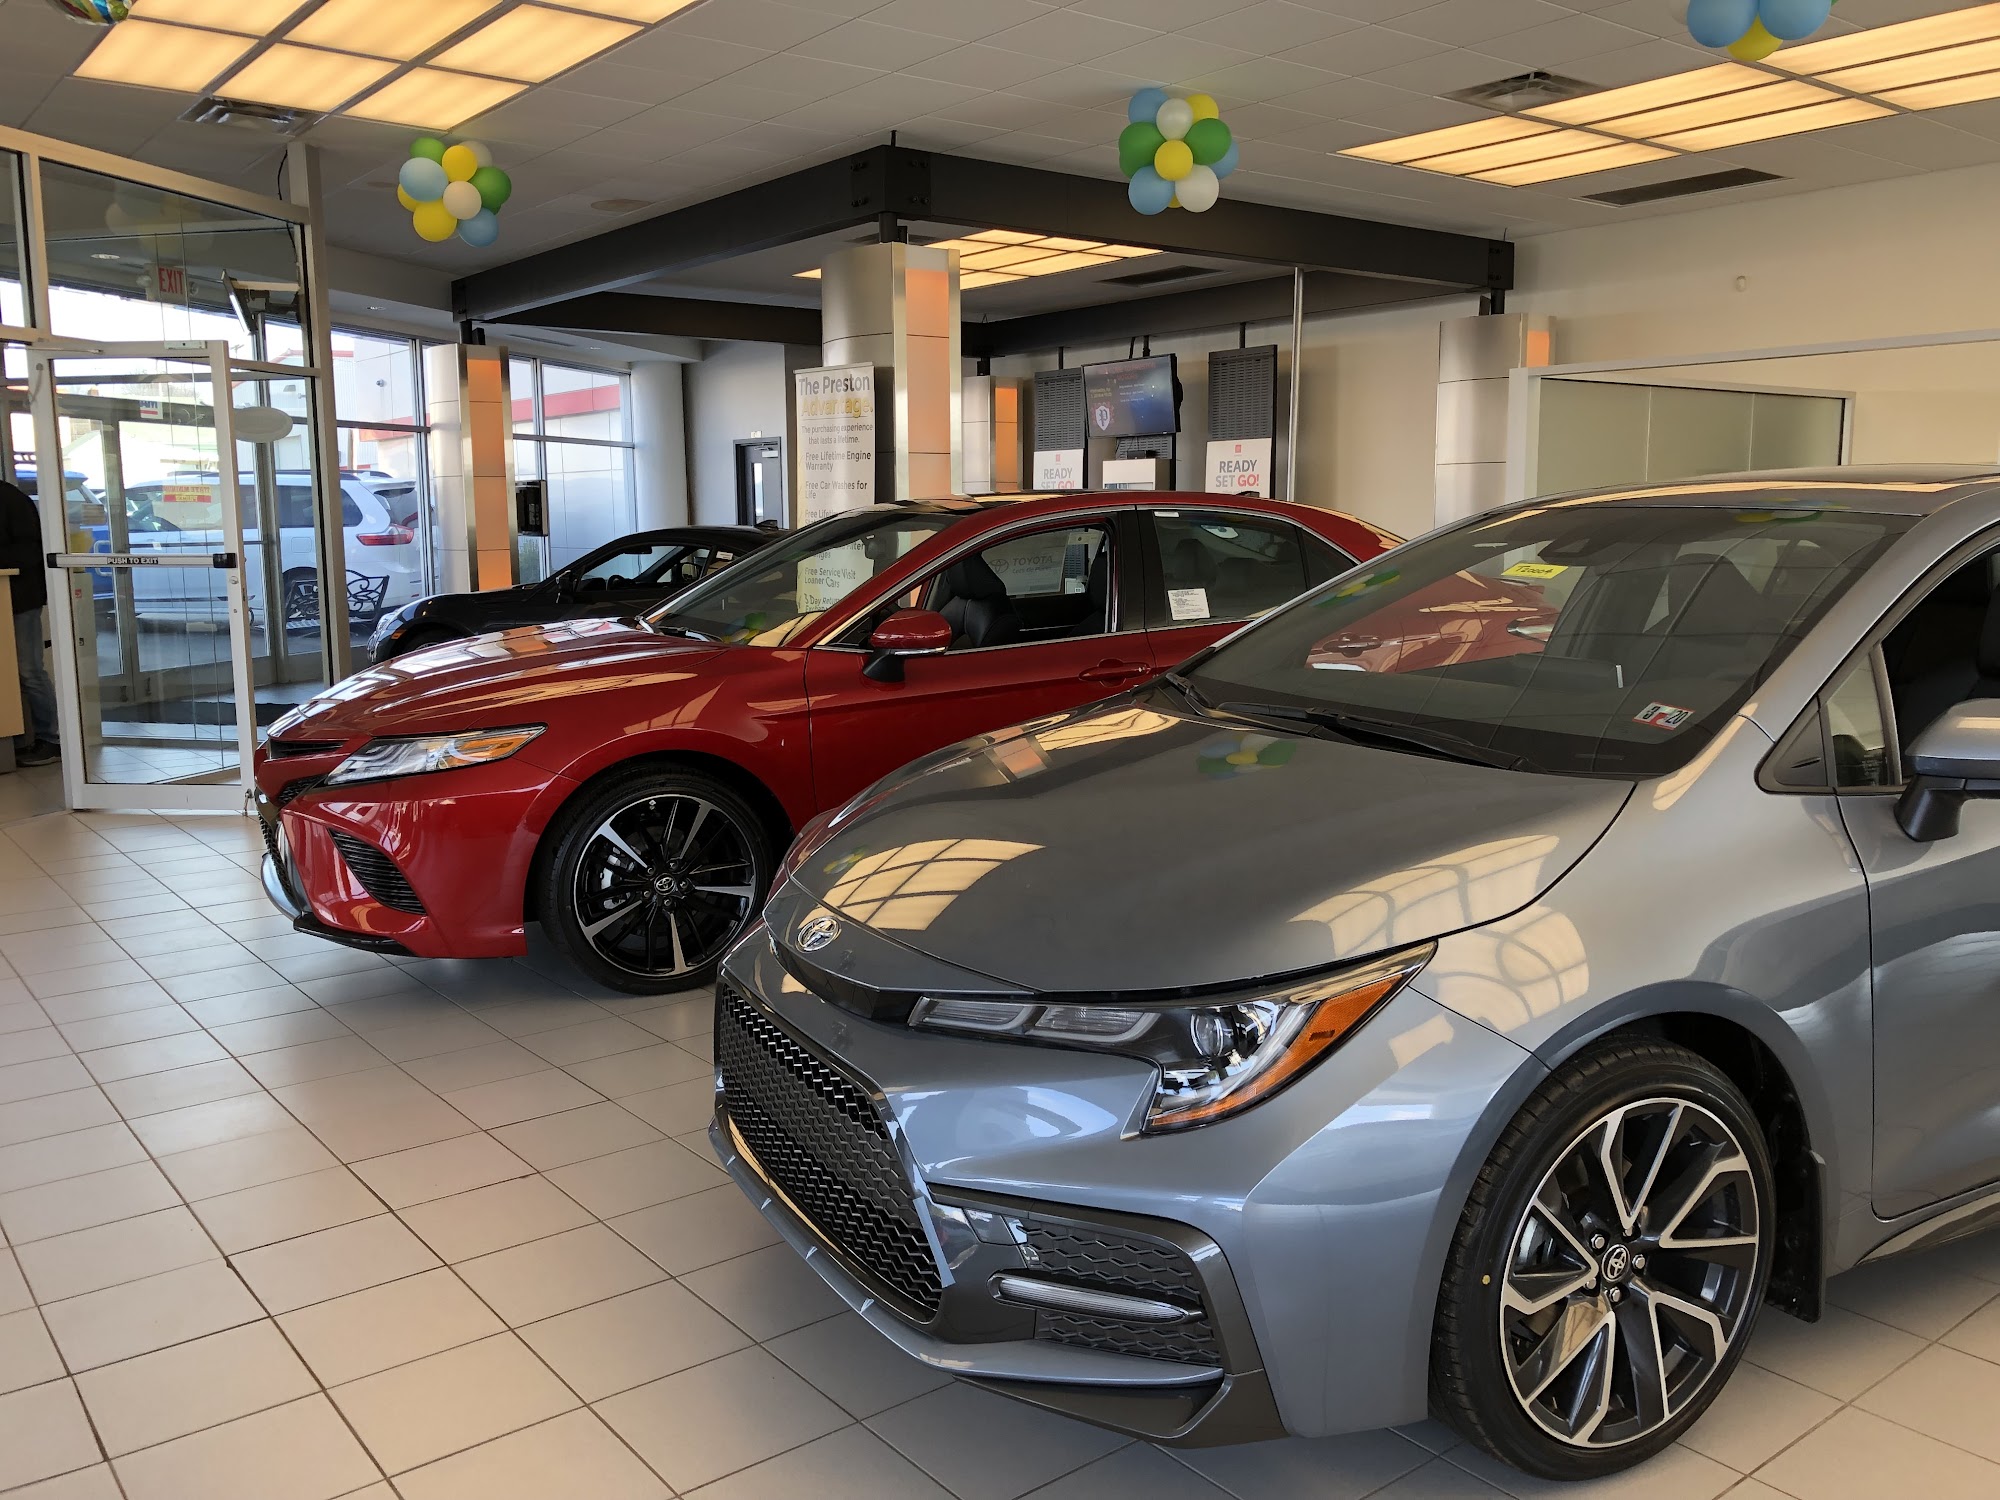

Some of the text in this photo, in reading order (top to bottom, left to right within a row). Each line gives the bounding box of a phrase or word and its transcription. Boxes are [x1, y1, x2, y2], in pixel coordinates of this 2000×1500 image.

[158, 267, 184, 294] EXIT
[799, 374, 870, 396] The Preston
[801, 423, 873, 434] The purchasing experience
[808, 436, 820, 444] that
[820, 436, 833, 444] lasts
[838, 435, 860, 443] lifetime.
[805, 450, 872, 462] Free Lifetime Engine
[805, 462, 834, 472] Warranty
[1219, 459, 1258, 473] READY
[1043, 467, 1073, 479] READY
[805, 480, 868, 490] Free Car Washes for
[1041, 481, 1075, 489] SET GO!
[1215, 474, 1260, 487] SET GO!
[805, 490, 817, 499] Life
[804, 509, 818, 518] Free
[1012, 555, 1053, 566] TOYOTA
[804, 567, 856, 580] Free Service Visit
[804, 576, 840, 588] Loaner Cars
[803, 593, 809, 605] 3
[809, 594, 821, 606] Day
[1665, 710, 1689, 724] 20
